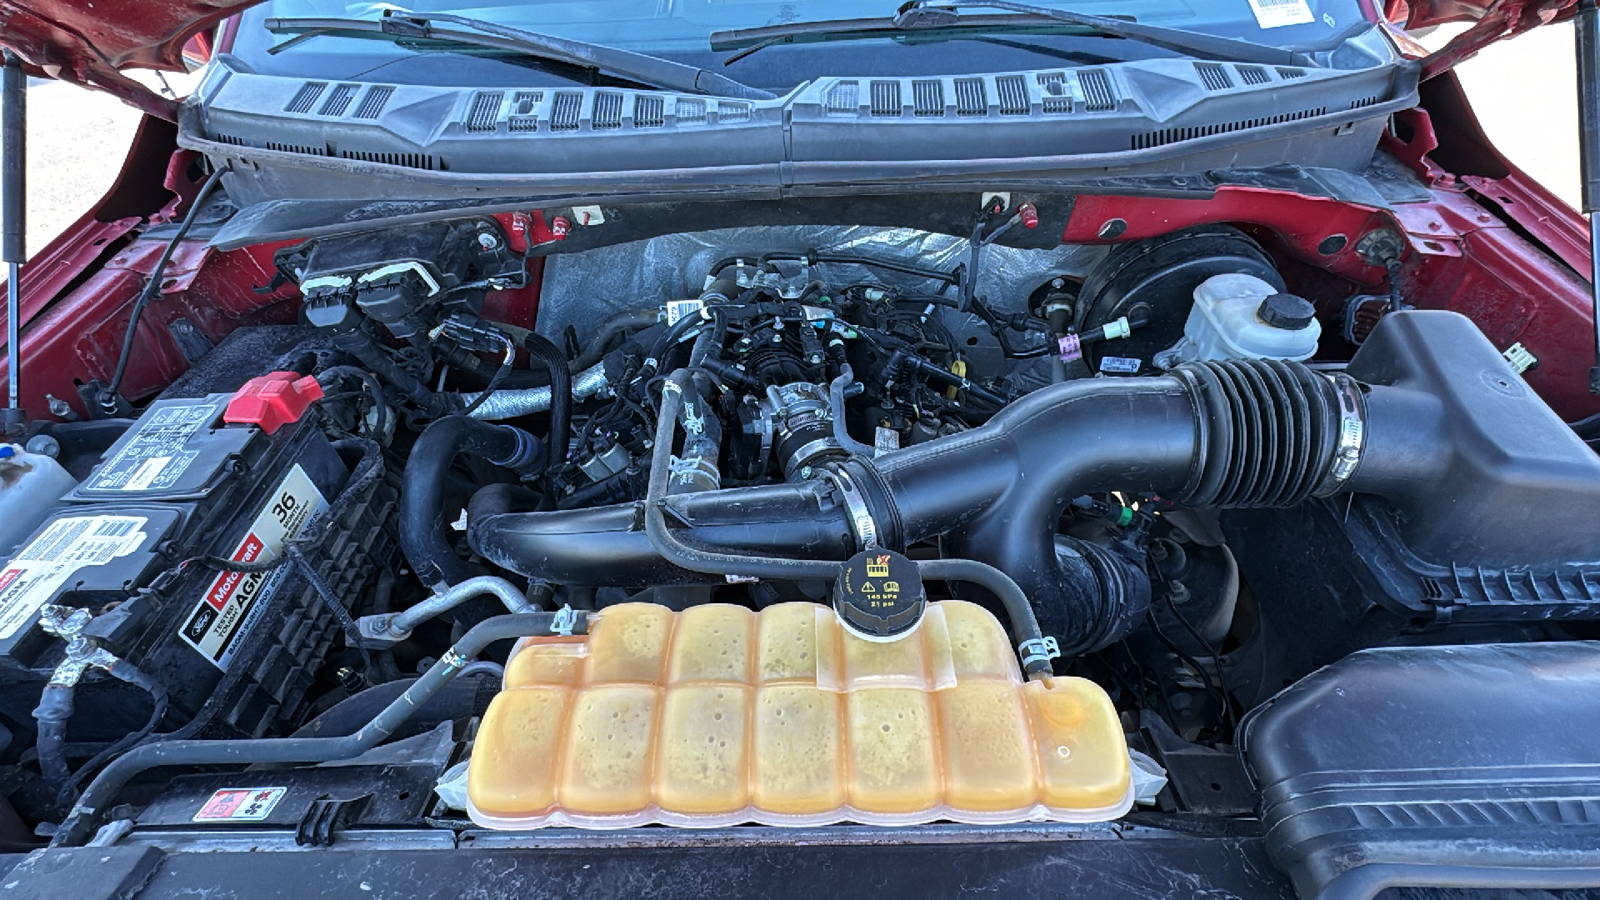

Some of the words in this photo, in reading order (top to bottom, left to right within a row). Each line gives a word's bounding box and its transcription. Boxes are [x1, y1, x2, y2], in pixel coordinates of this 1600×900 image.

[271, 491, 296, 524] 36
[283, 503, 301, 529] MONTH
[213, 604, 236, 634] TESTED
